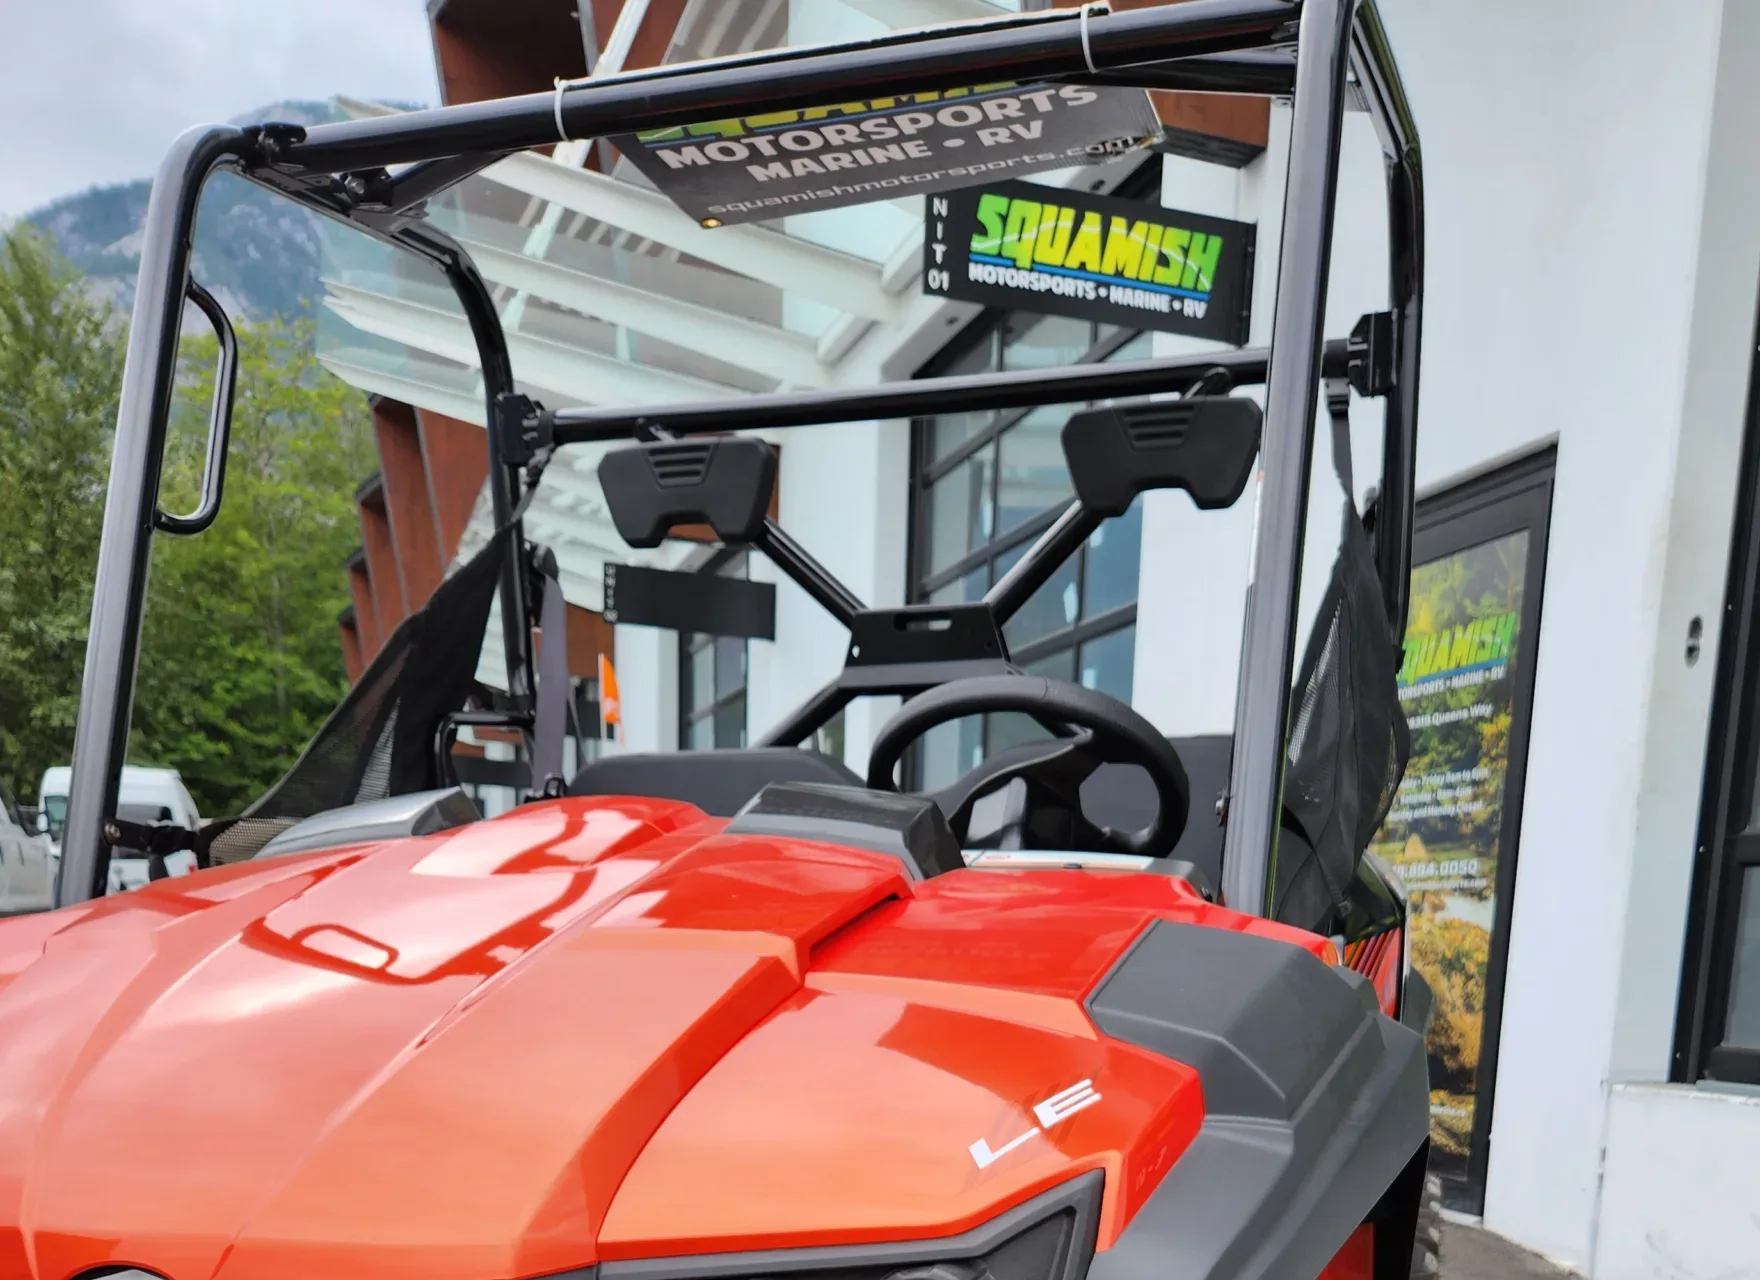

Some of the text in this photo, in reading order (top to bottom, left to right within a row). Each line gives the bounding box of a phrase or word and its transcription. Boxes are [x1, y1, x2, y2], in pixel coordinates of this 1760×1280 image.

[655, 85, 1098, 169] MOTORSPORTS
[746, 119, 1043, 182] MARINE RV
[708, 135, 1135, 214] squamishmotorsports.com
[931, 196, 949, 265] NIT
[969, 193, 1224, 293] SQUAMISH
[927, 267, 950, 292] 01
[968, 262, 1207, 320] MOTORSPORTS MARINE RV
[1398, 665, 1505, 701] TORSPORTS MARINE RV
[1407, 713, 1432, 730] 9319
[1469, 702, 1493, 718] Way
[968, 1078, 1102, 1169] LE
